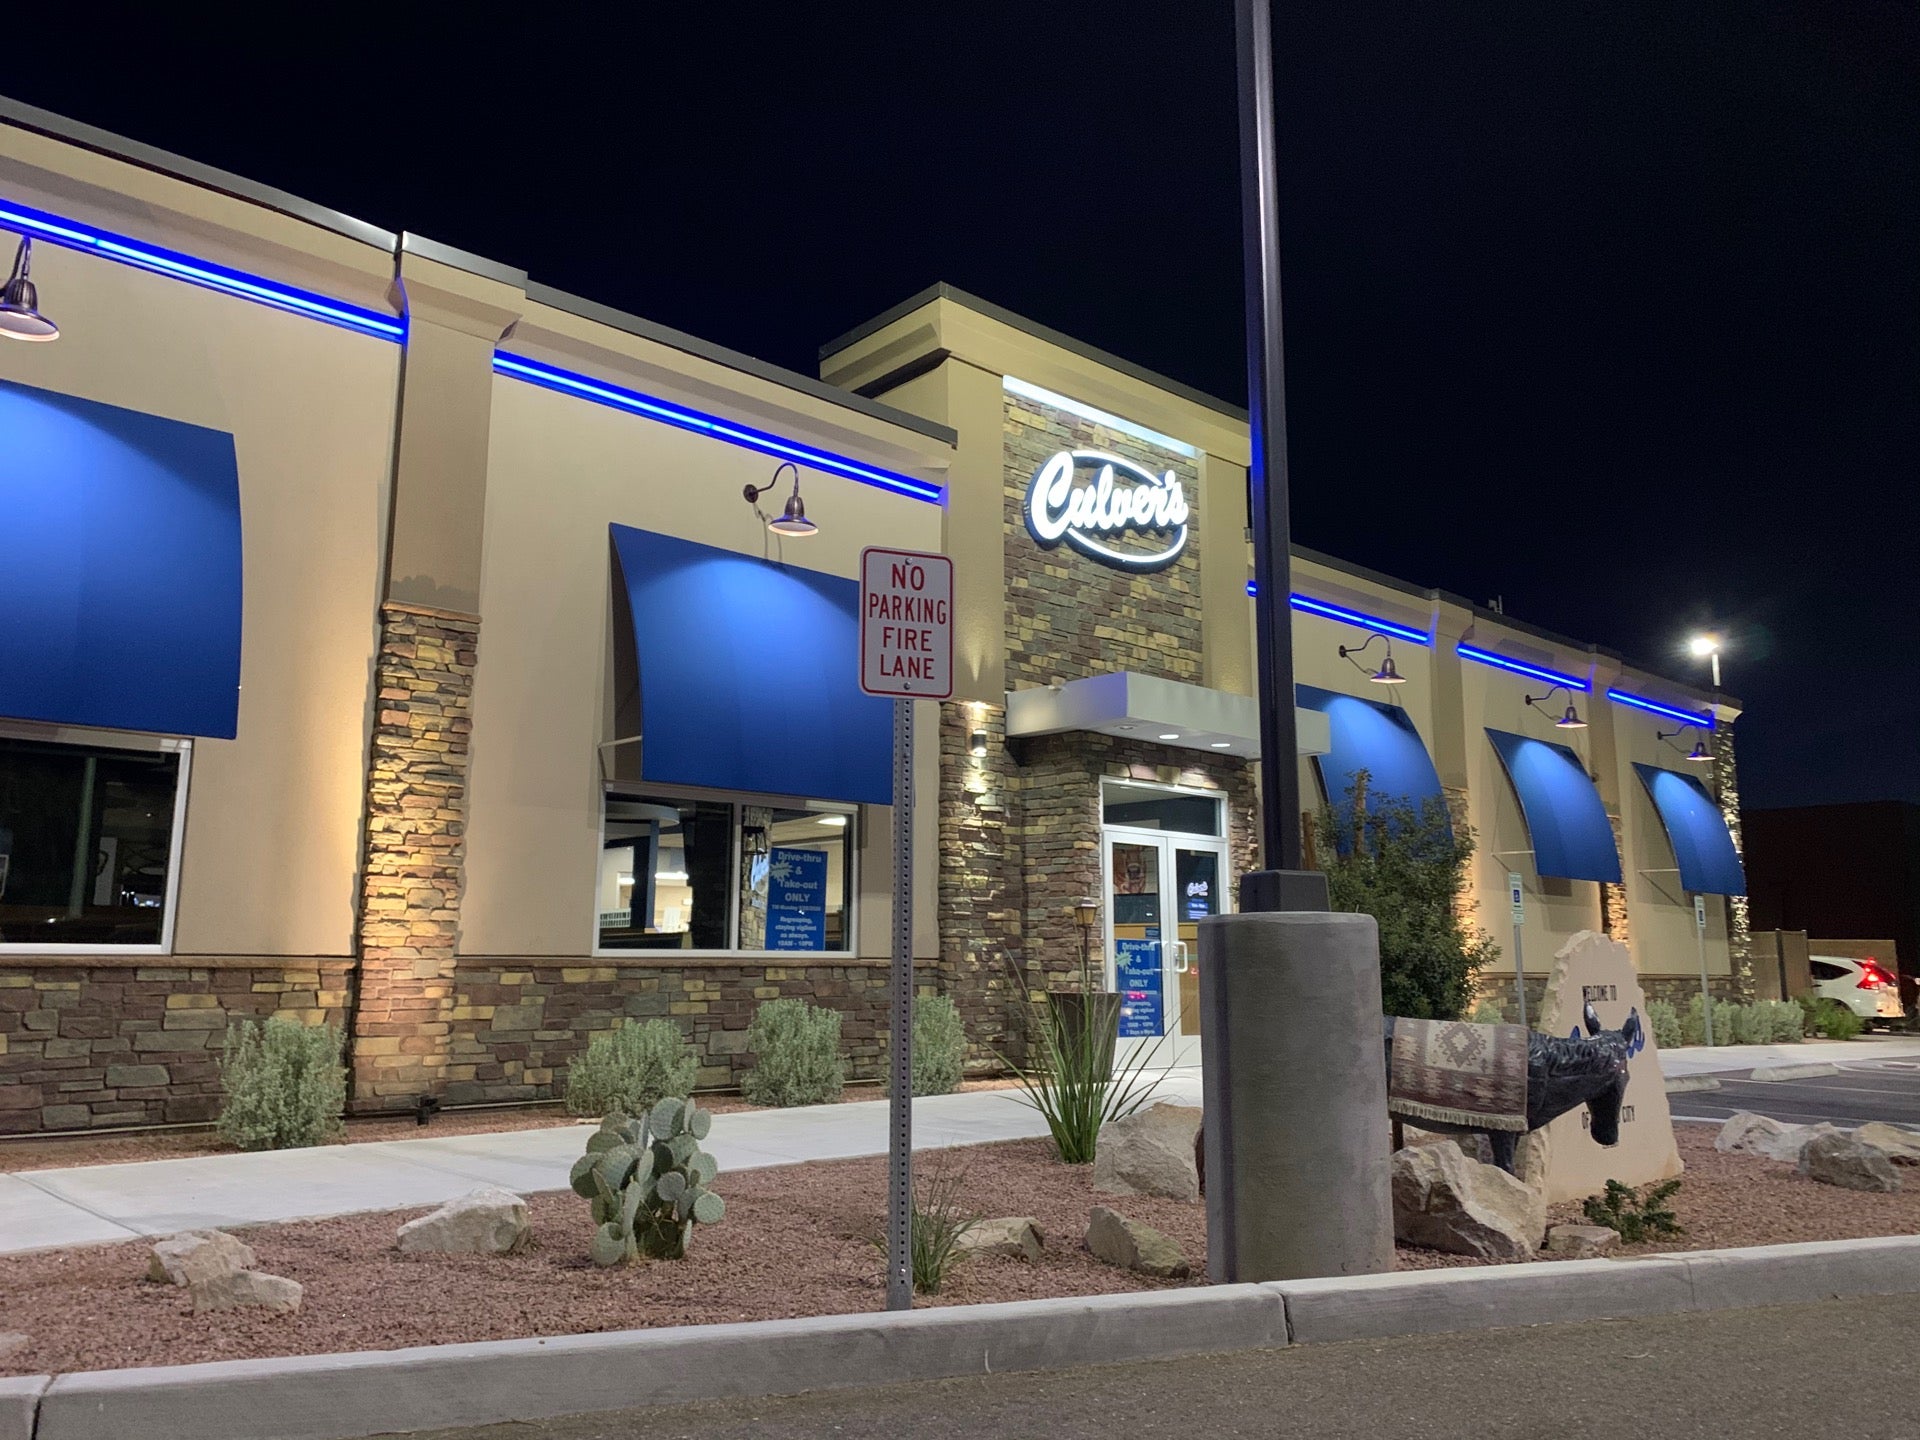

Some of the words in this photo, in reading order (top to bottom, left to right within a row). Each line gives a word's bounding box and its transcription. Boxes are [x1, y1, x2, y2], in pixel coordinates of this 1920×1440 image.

[1025, 450, 1189, 545] Culver's
[891, 563, 925, 591] NO
[869, 592, 947, 625] PARKING
[883, 626, 932, 652] FIRE
[880, 653, 935, 680] LANE
[778, 851, 822, 863] Drive-thru
[795, 866, 803, 875] &
[778, 879, 818, 890] Take-out
[785, 893, 810, 902] ONLY
[1129, 979, 1149, 988] ONLY
